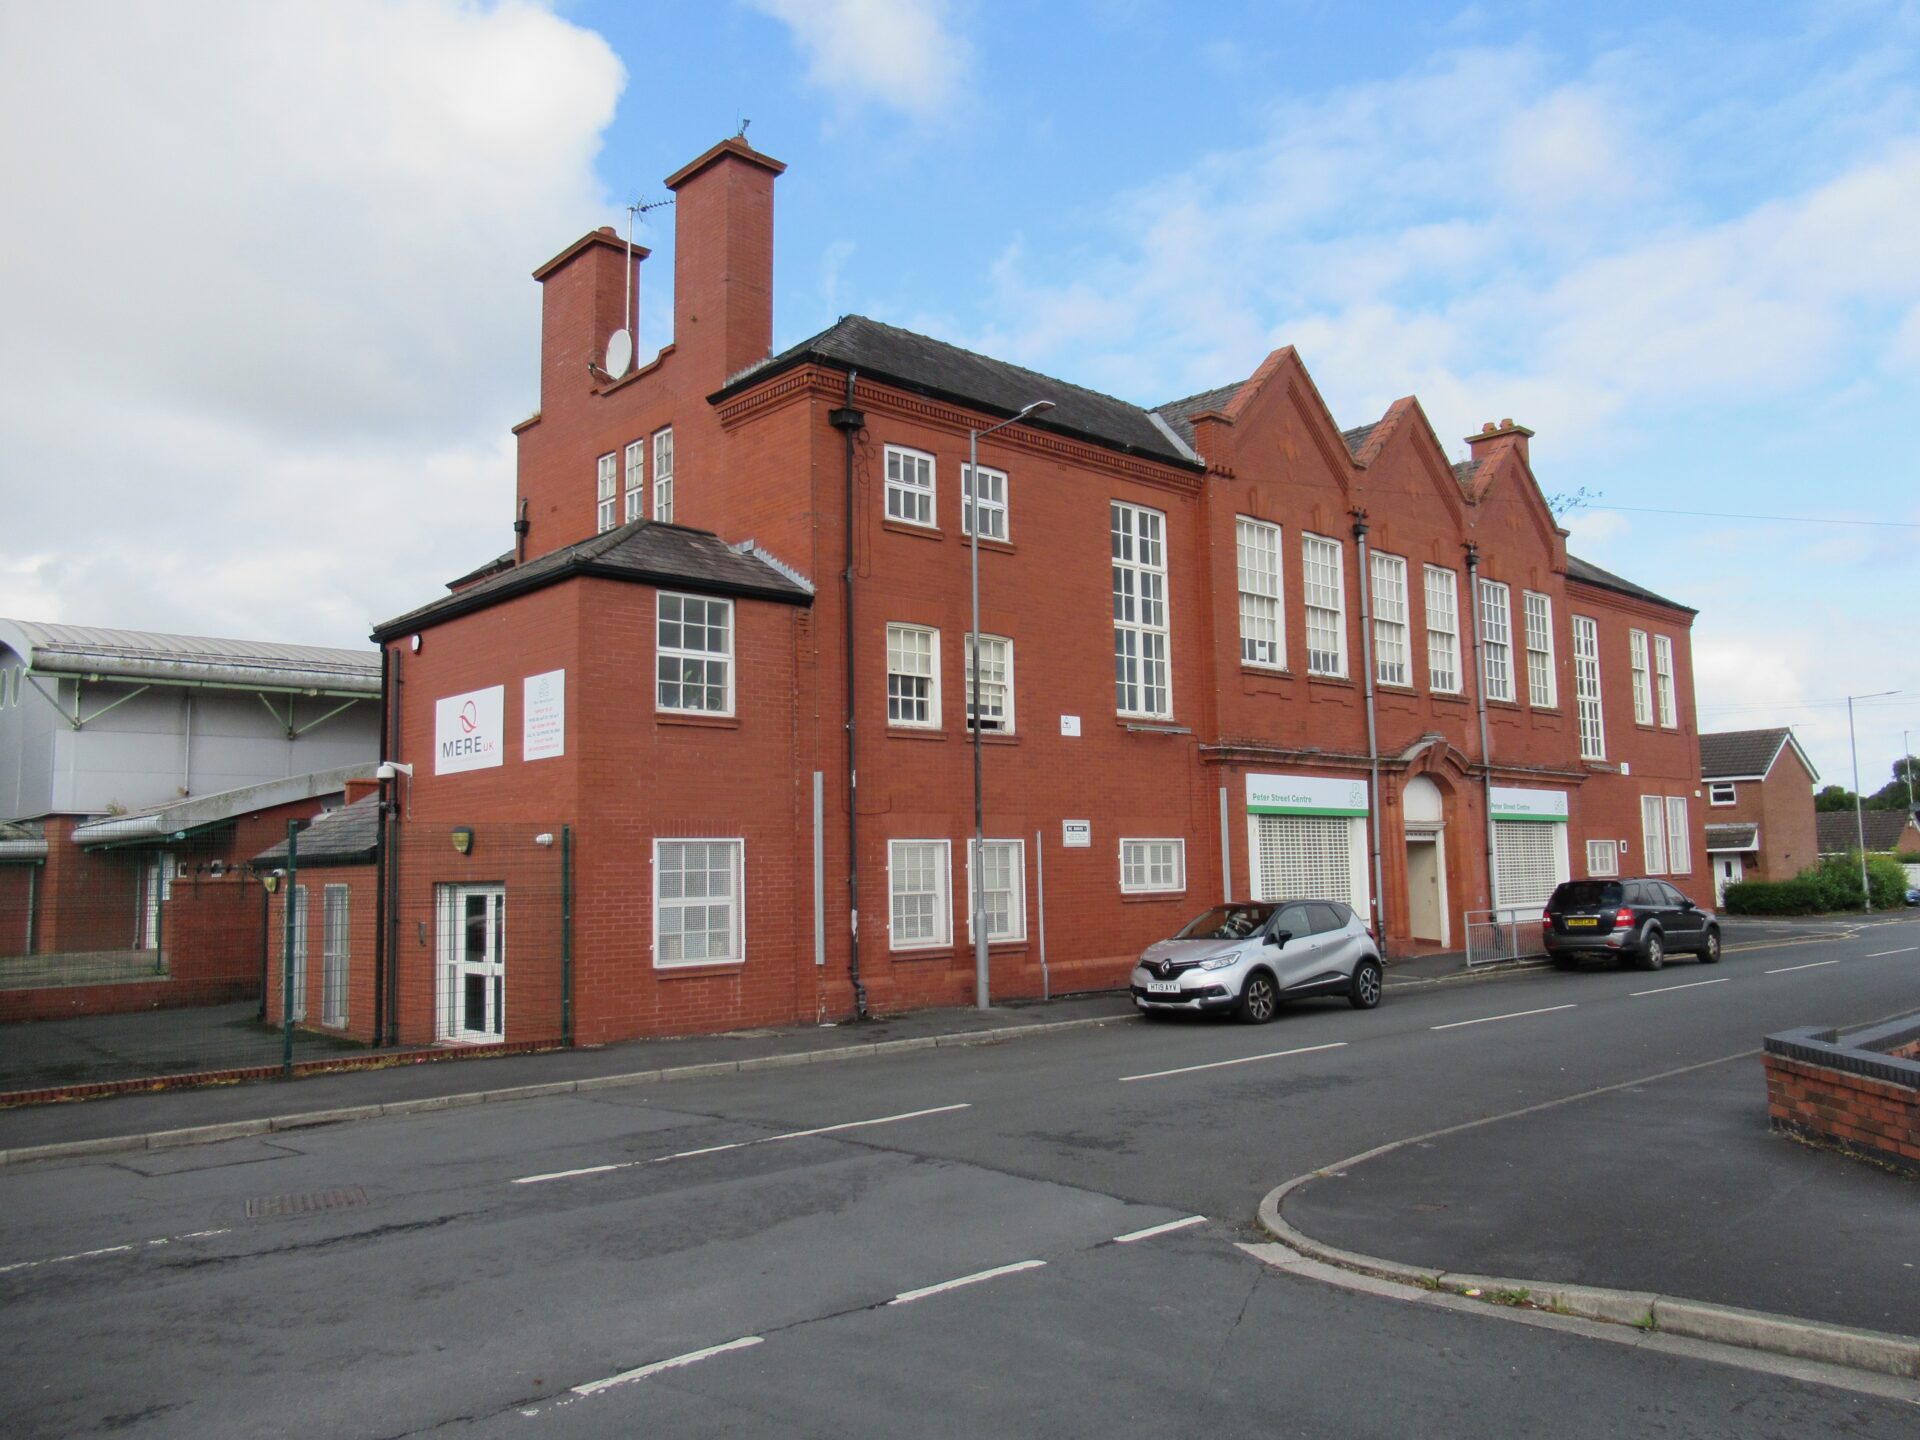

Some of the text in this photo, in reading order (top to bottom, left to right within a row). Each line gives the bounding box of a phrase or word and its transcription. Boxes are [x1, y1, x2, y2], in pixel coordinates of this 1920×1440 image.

[443, 736, 482, 758] MERE
[1252, 793, 1312, 803] Peter Street Centre
